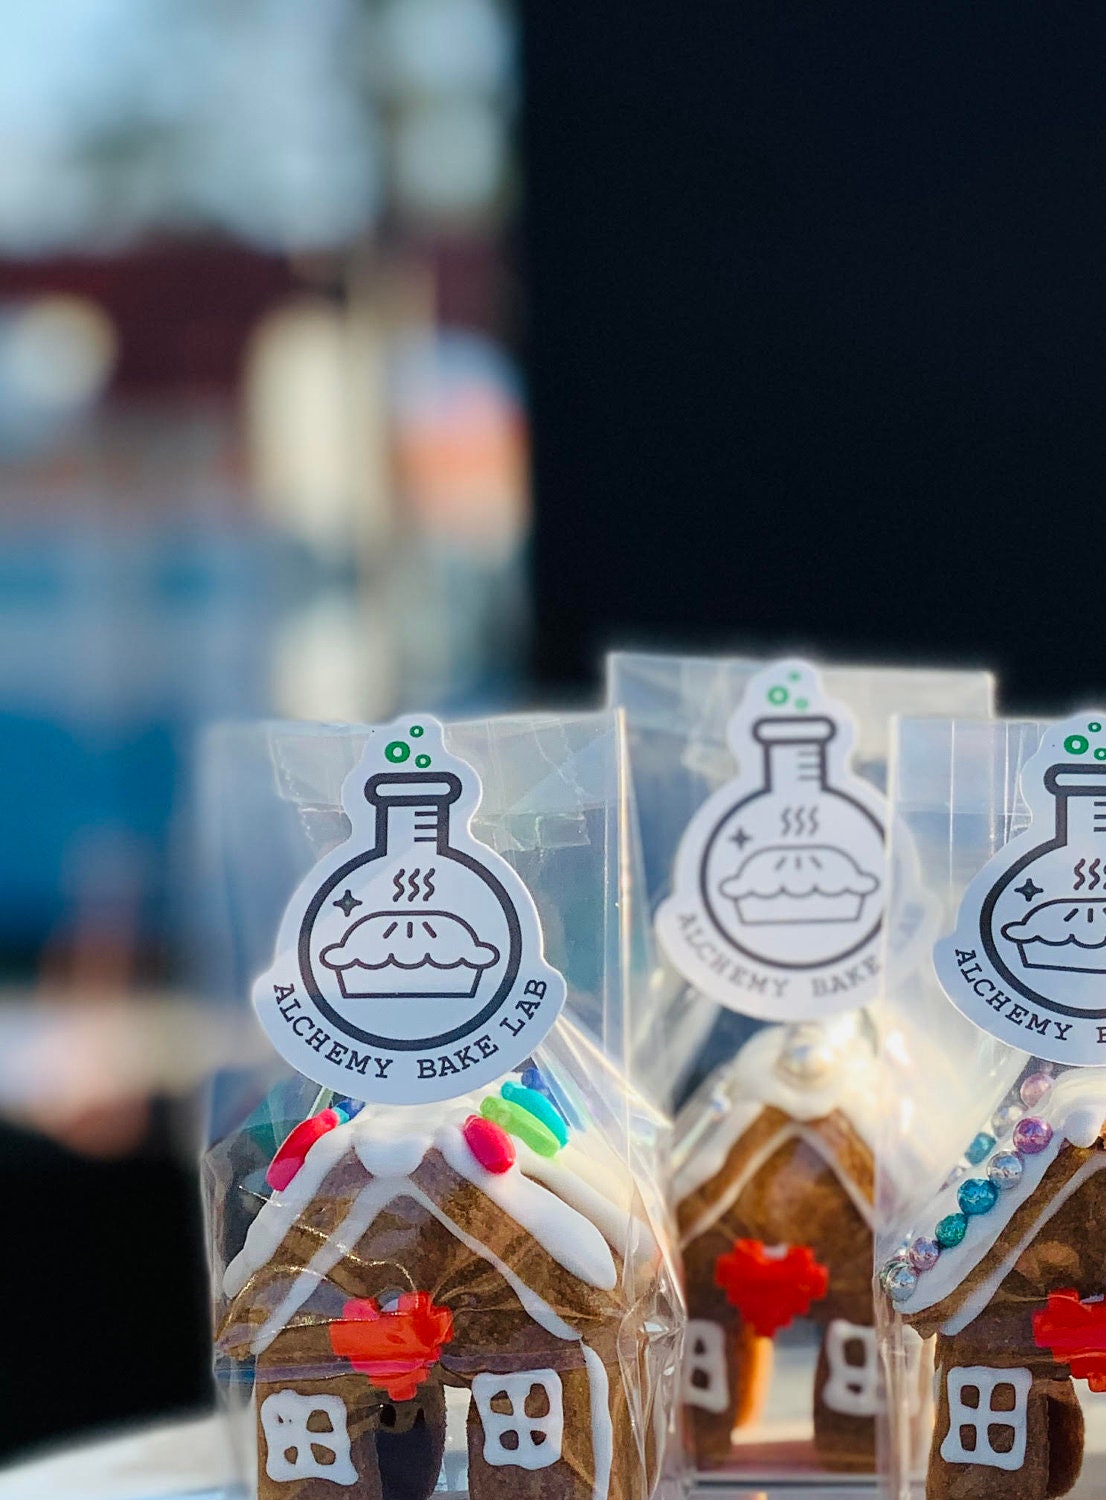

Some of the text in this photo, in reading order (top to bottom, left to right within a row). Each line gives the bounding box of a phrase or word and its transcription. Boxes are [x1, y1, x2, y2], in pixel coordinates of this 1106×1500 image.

[678, 912, 880, 997] ALCHEMY BAKE
[955, 949, 1073, 1040] ALCHEMY
[273, 979, 548, 1079] ALCHEMY BAKE LAB
